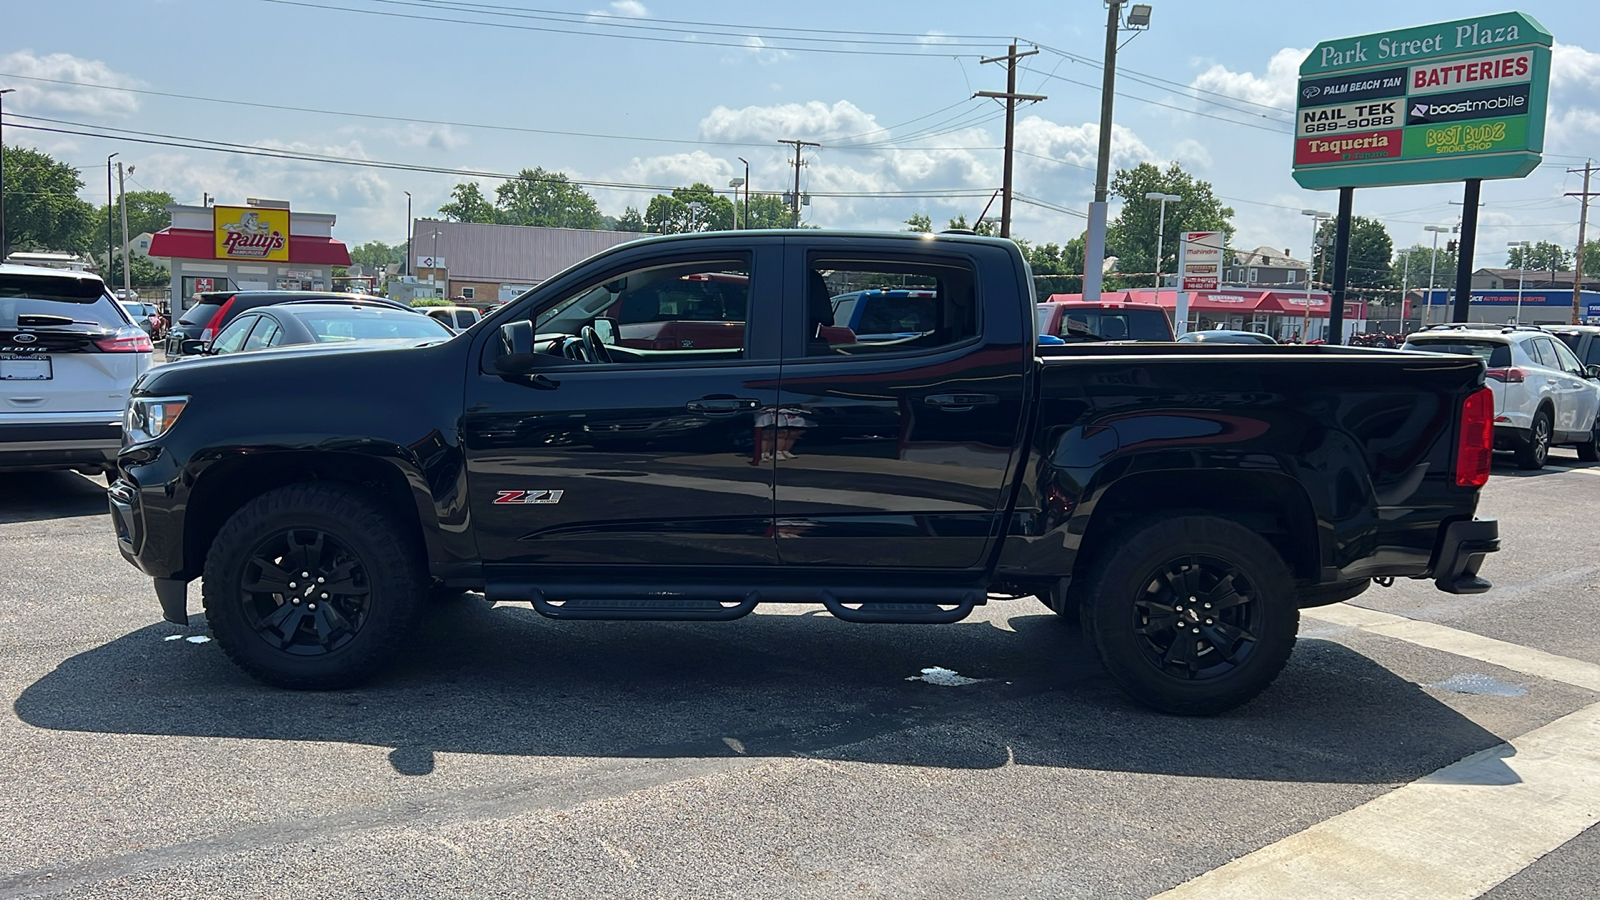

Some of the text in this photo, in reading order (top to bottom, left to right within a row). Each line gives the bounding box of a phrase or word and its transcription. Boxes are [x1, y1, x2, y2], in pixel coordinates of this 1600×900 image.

[1321, 22, 1520, 67] Park Street Plaza
[1414, 56, 1528, 88] BATTERIES
[1323, 76, 1402, 95] PALM BEACH TAN
[1303, 101, 1396, 123] NAIL TEK
[1305, 115, 1394, 133] 689-9088
[1463, 122, 1506, 144] BUDZ
[1308, 133, 1389, 154] Taquería
[1436, 142, 1492, 154] SMOKE SHOP
[222, 230, 285, 256] Rally's
[492, 489, 565, 504] Z71
